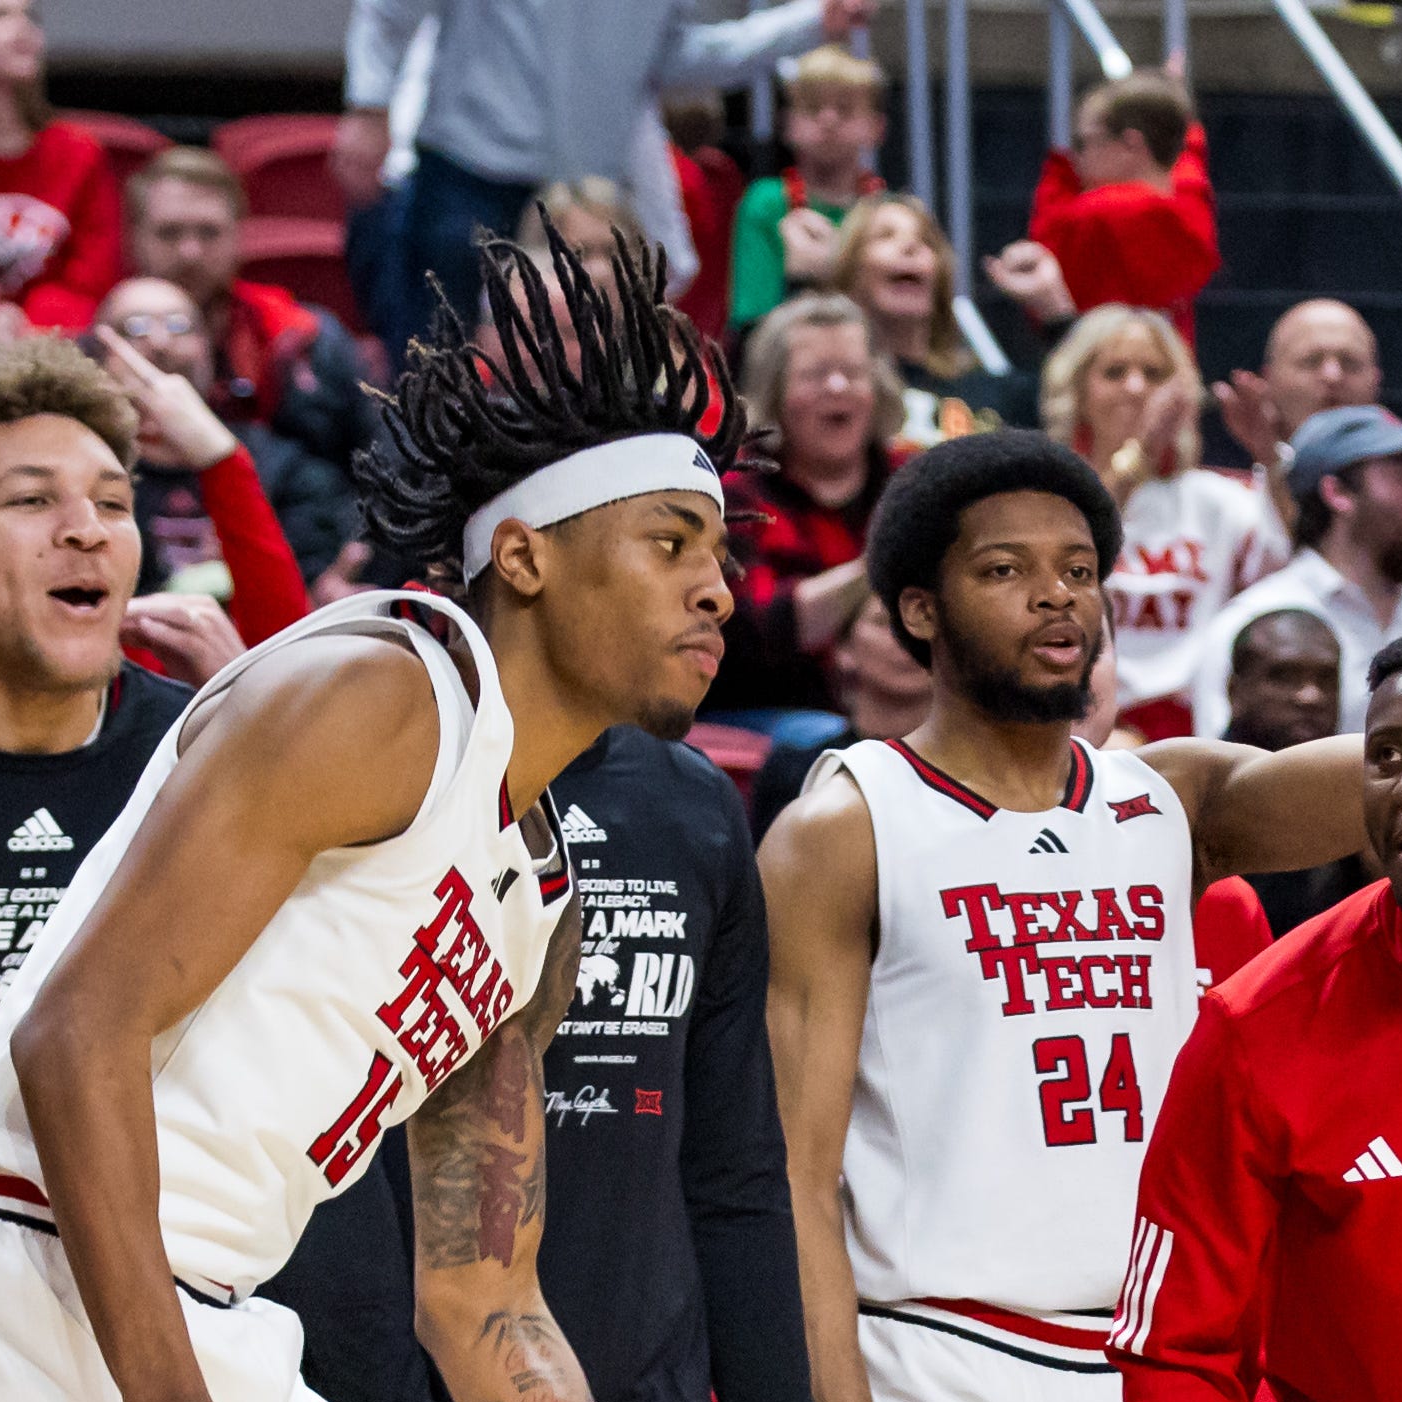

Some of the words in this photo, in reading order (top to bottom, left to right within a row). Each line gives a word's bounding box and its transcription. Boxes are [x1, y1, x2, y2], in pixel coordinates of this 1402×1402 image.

[10, 887, 69, 903] GOIN
[18, 904, 35, 918] A
[585, 894, 597, 907] A
[625, 880, 645, 893] TO
[939, 882, 1164, 953] TEXAS
[412, 864, 515, 1040] TEXAS
[587, 910, 608, 938] A
[611, 910, 688, 939] MARK
[979, 944, 1152, 1017] TECH
[375, 942, 470, 1095] TECH
[305, 1048, 404, 1190] 15
[1032, 1033, 1155, 1147] 24
